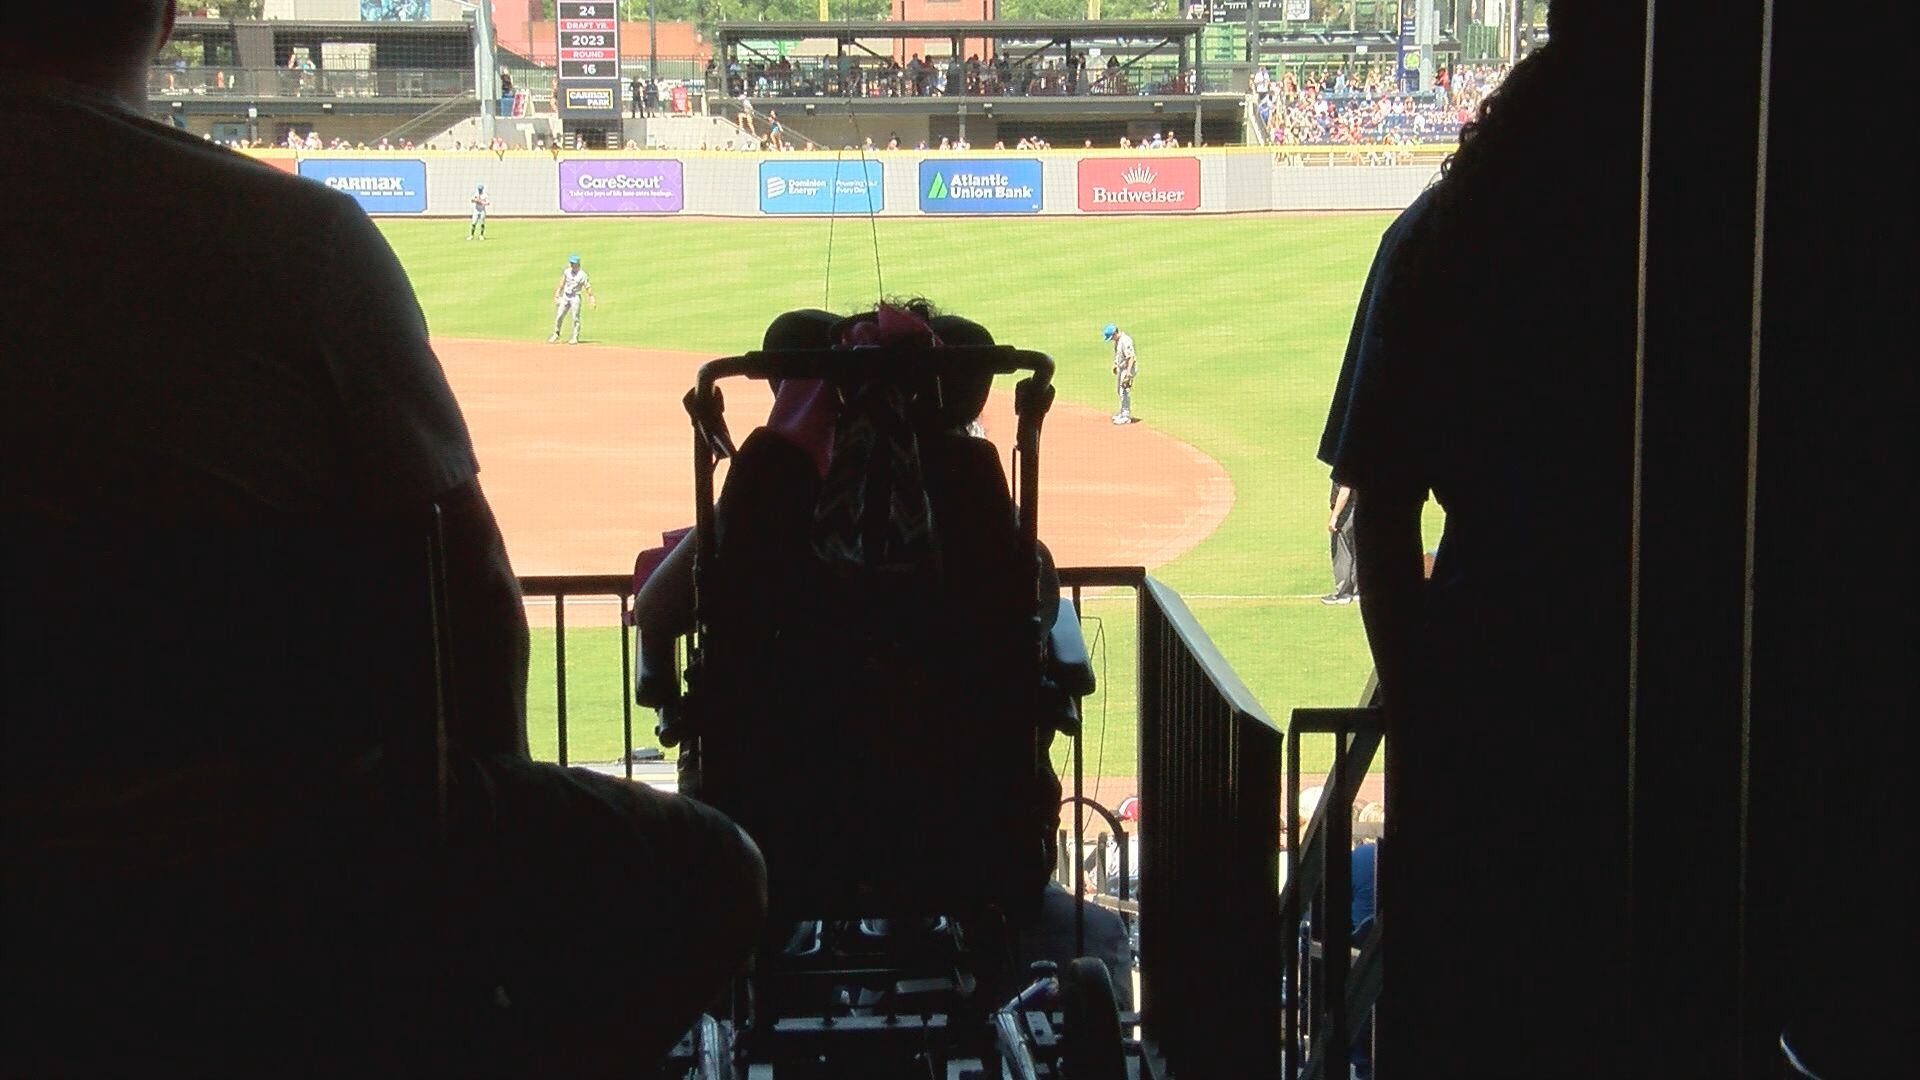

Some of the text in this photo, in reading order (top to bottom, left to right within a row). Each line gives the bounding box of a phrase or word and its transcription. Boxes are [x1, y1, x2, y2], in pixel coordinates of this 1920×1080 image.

[579, 6, 596, 16] 24
[572, 35, 605, 46] 2023
[582, 64, 597, 75] 16
[587, 98, 609, 106] PARK
[578, 174, 661, 189] CareScout
[788, 179, 827, 187] Dominion
[951, 174, 1009, 187] Atlantic
[788, 187, 818, 196] Energy
[950, 185, 1032, 199] Union Bank
[1092, 187, 1185, 204] Budweiser
